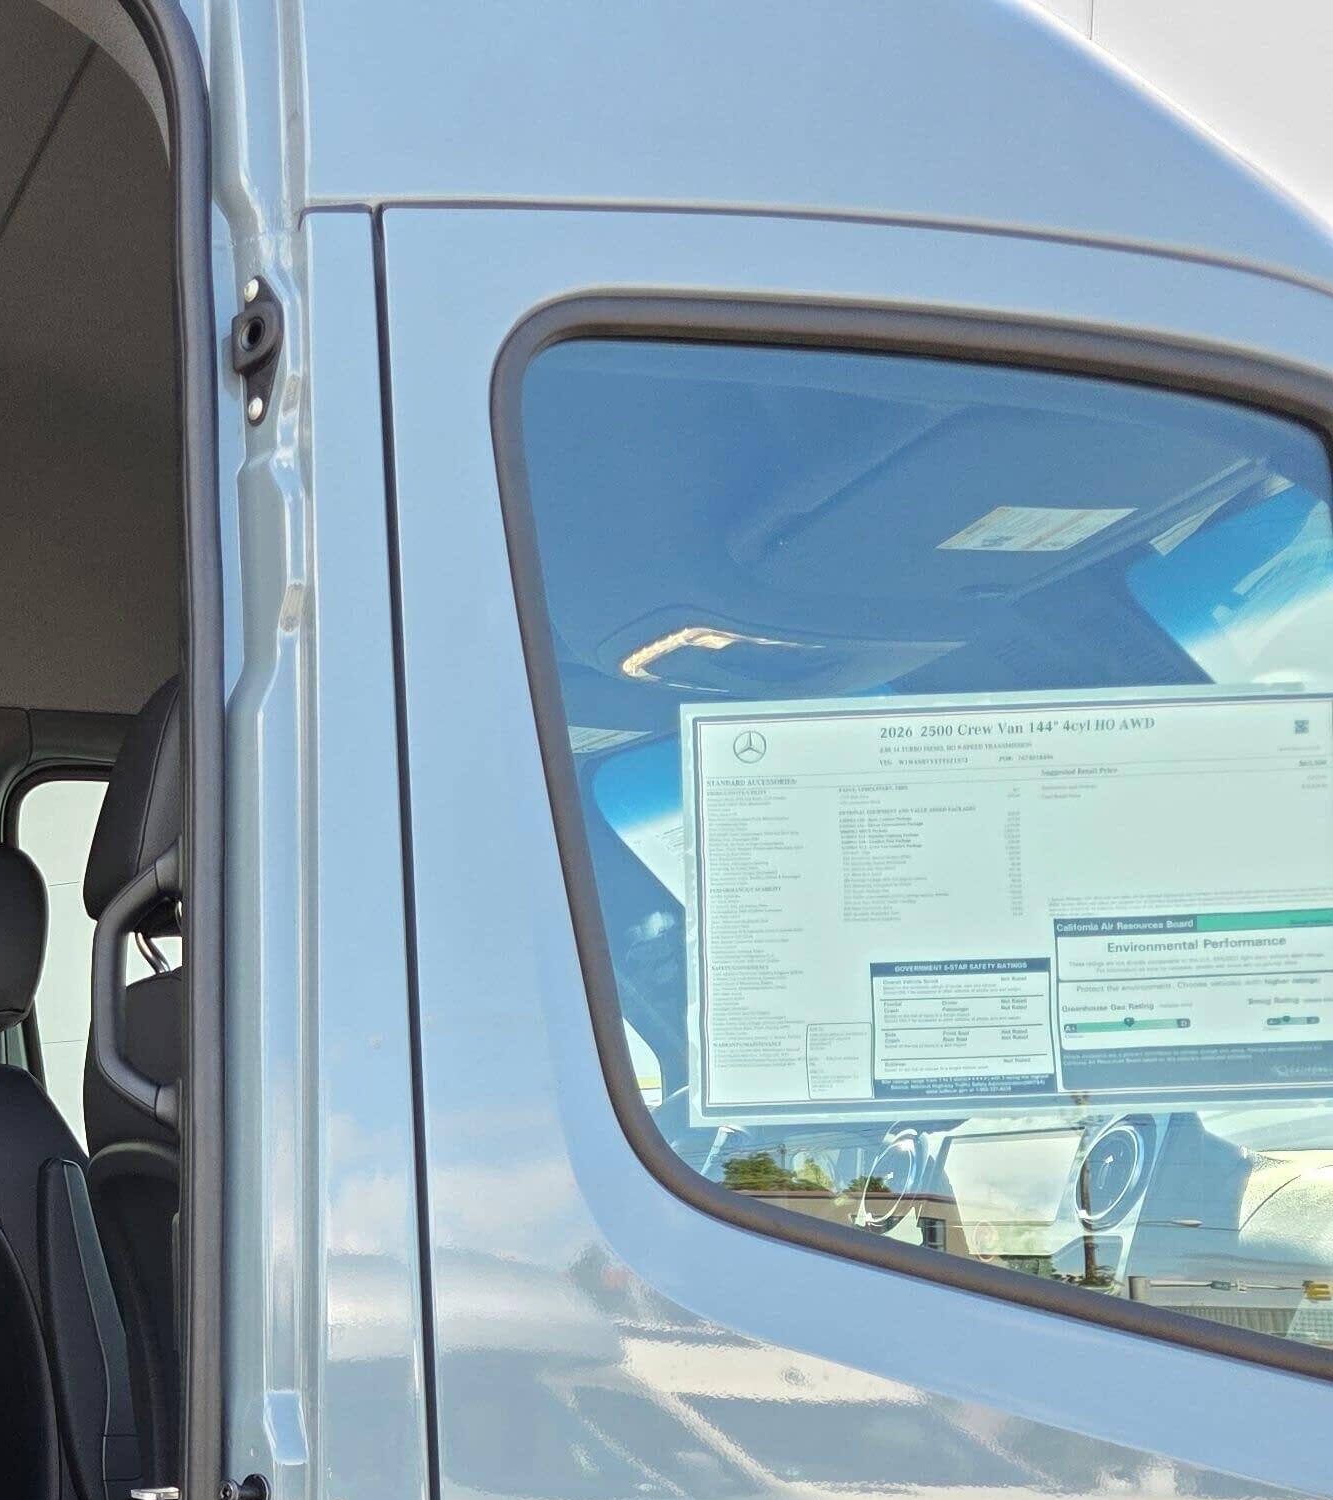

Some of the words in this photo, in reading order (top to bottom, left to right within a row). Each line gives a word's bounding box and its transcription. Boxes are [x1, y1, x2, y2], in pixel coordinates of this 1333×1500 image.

[880, 727, 913, 739] 2026
[920, 725, 954, 737] 2500
[957, 723, 993, 736] Crew
[998, 722, 1023, 734] Van
[1062, 719, 1091, 734] 4cyl
[1119, 717, 1155, 730] AWD
[1056, 923, 1099, 932] California
[1101, 922, 1113, 931] Air
[1116, 920, 1163, 930] Resources
[1166, 919, 1194, 929] Board
[1107, 939, 1199, 953] Environmental
[1203, 936, 1286, 949] Performance
[894, 964, 942, 972] GOVERNMENT
[969, 962, 995, 970] SAFETY
[996, 961, 1027, 969] RATINGS
